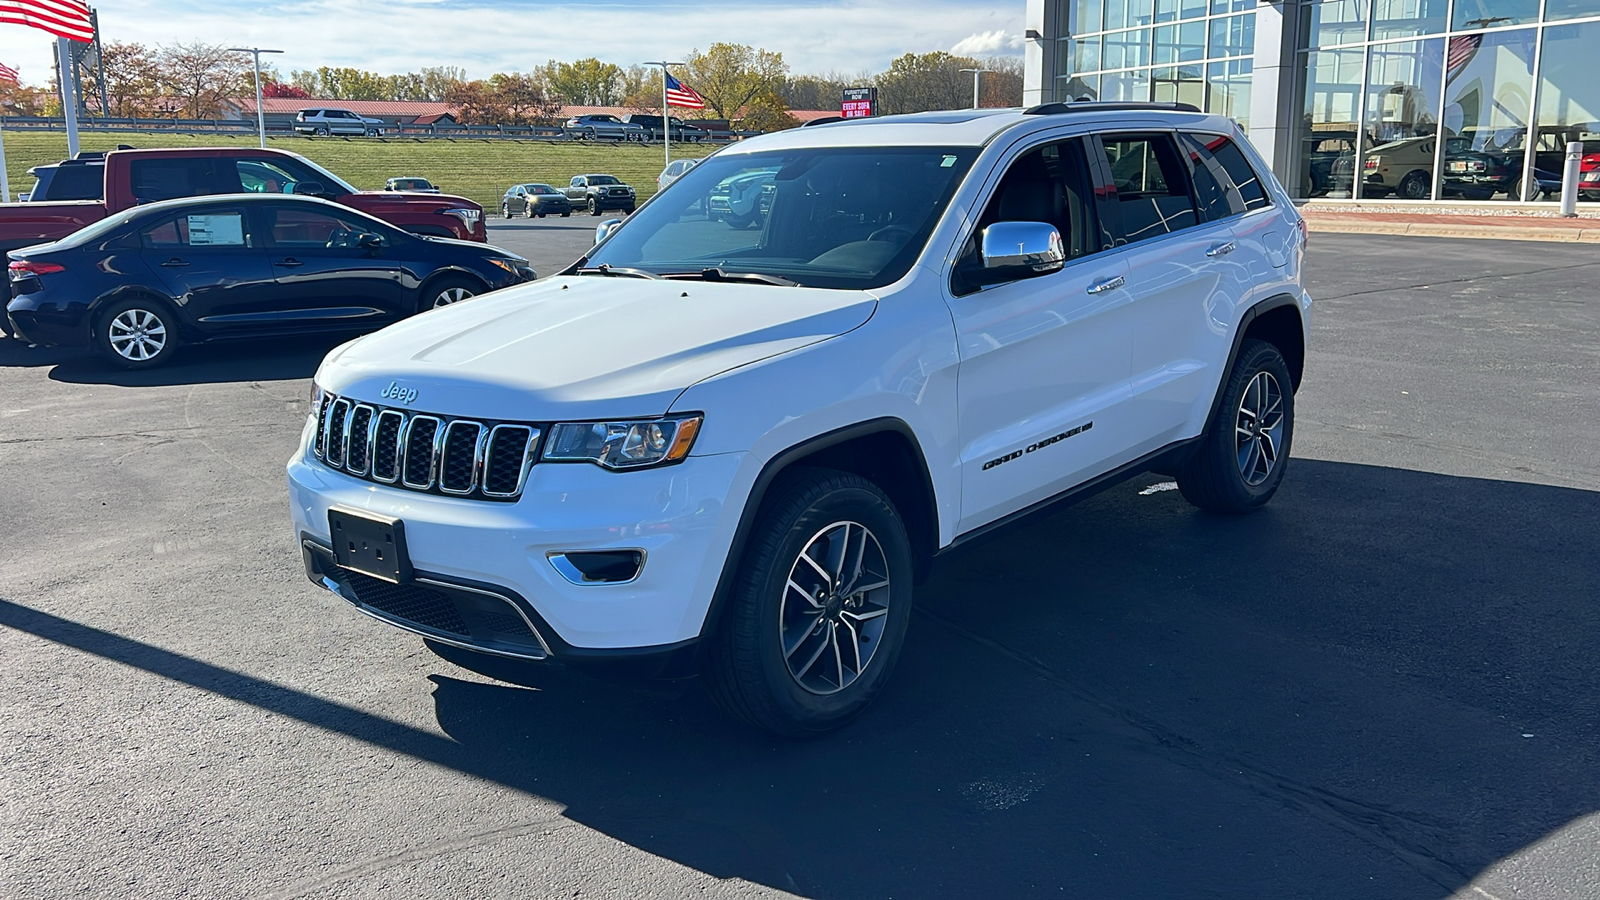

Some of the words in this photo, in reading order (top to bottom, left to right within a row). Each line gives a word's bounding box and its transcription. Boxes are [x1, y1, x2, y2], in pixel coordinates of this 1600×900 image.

[842, 102, 857, 110] EVERY
[857, 101, 870, 110] SOFA
[380, 381, 419, 405] Jeep
[982, 449, 1023, 471] GRAND
[1025, 426, 1082, 454] CHEROKEE
